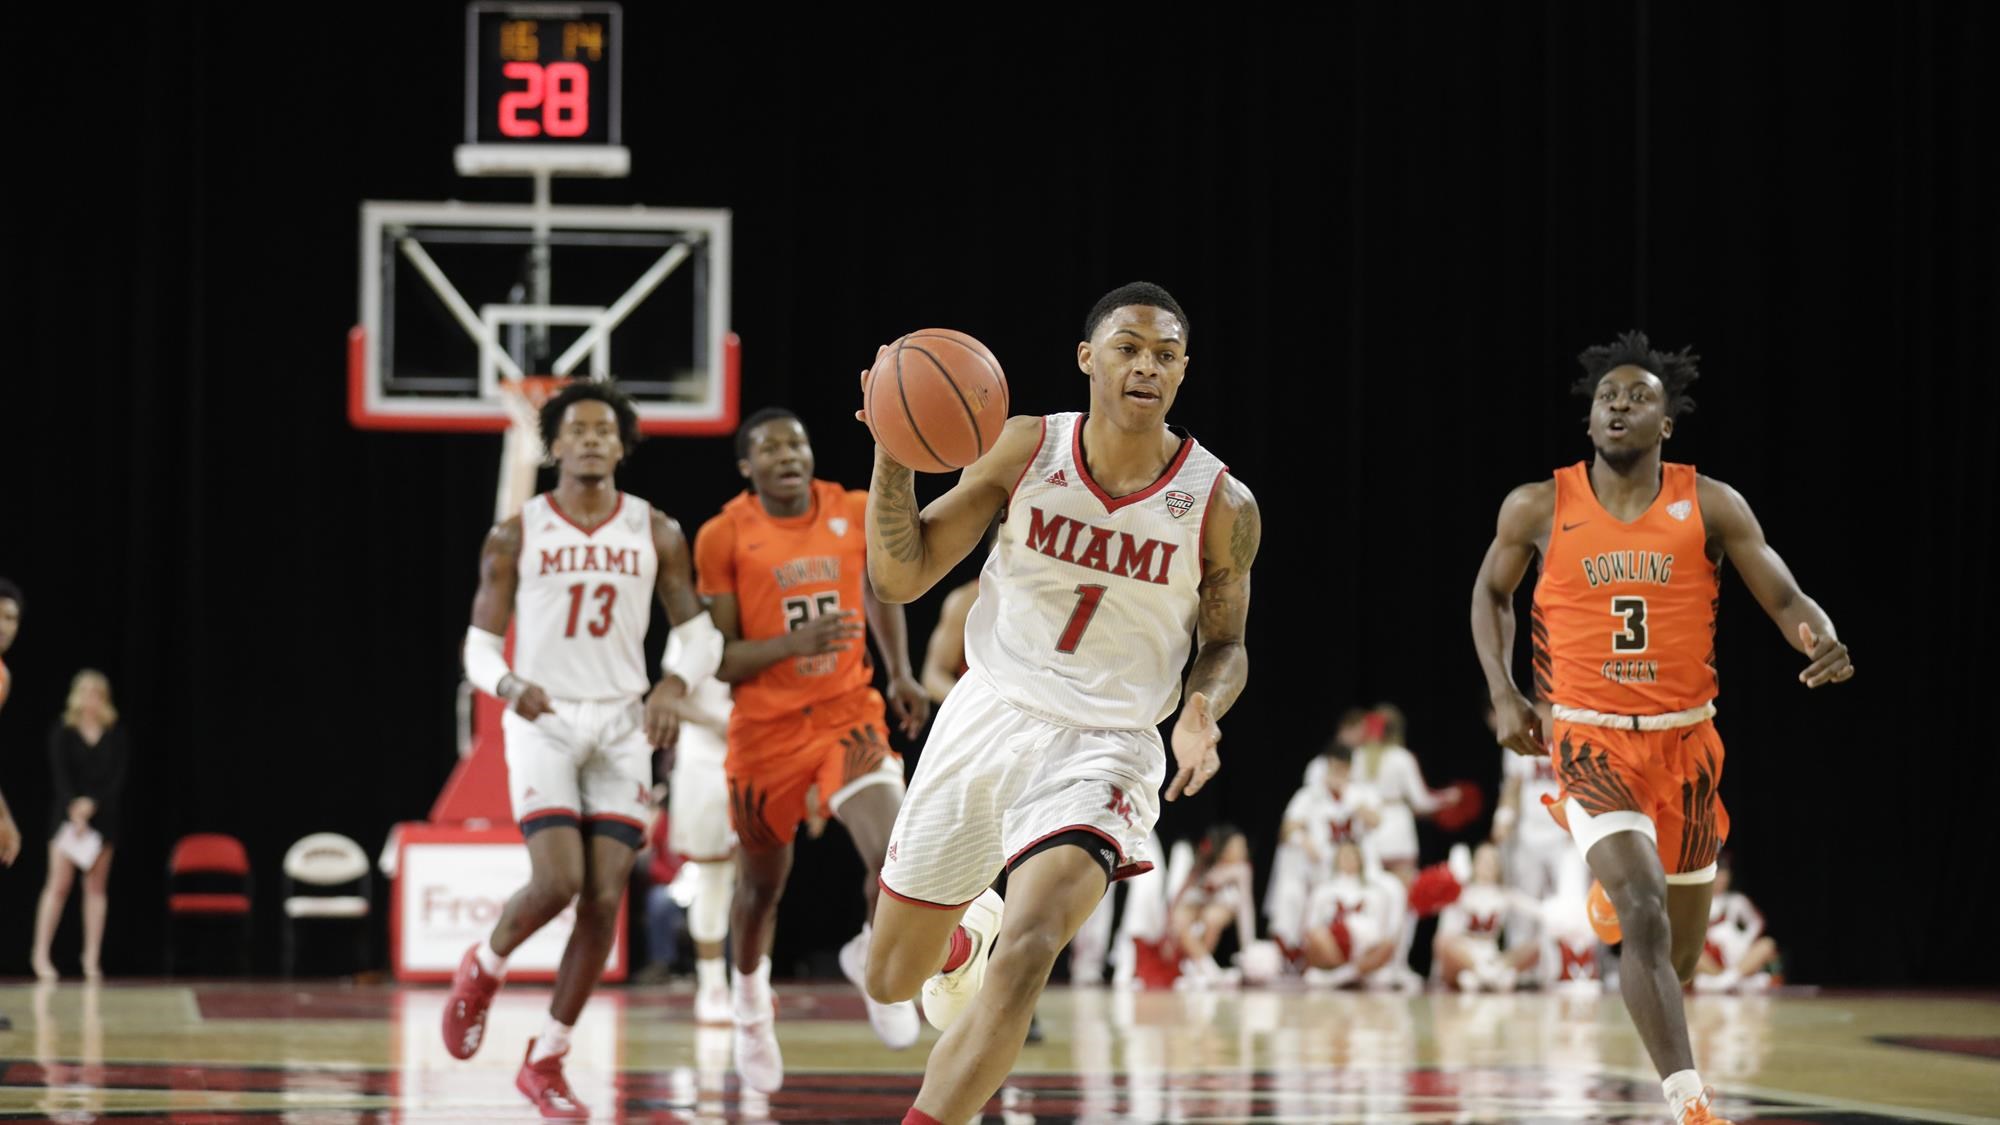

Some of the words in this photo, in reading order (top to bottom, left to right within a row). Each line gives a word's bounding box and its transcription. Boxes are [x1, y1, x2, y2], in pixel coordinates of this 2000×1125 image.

[498, 61, 589, 137] 28
[539, 545, 640, 577] MIAMI
[1025, 506, 1179, 585] MIAMI
[1582, 551, 1674, 588] BOWLING
[564, 583, 618, 639] 13
[1054, 584, 1108, 655] 1
[1610, 595, 1649, 653] 3
[1601, 659, 1659, 684] GREEN
